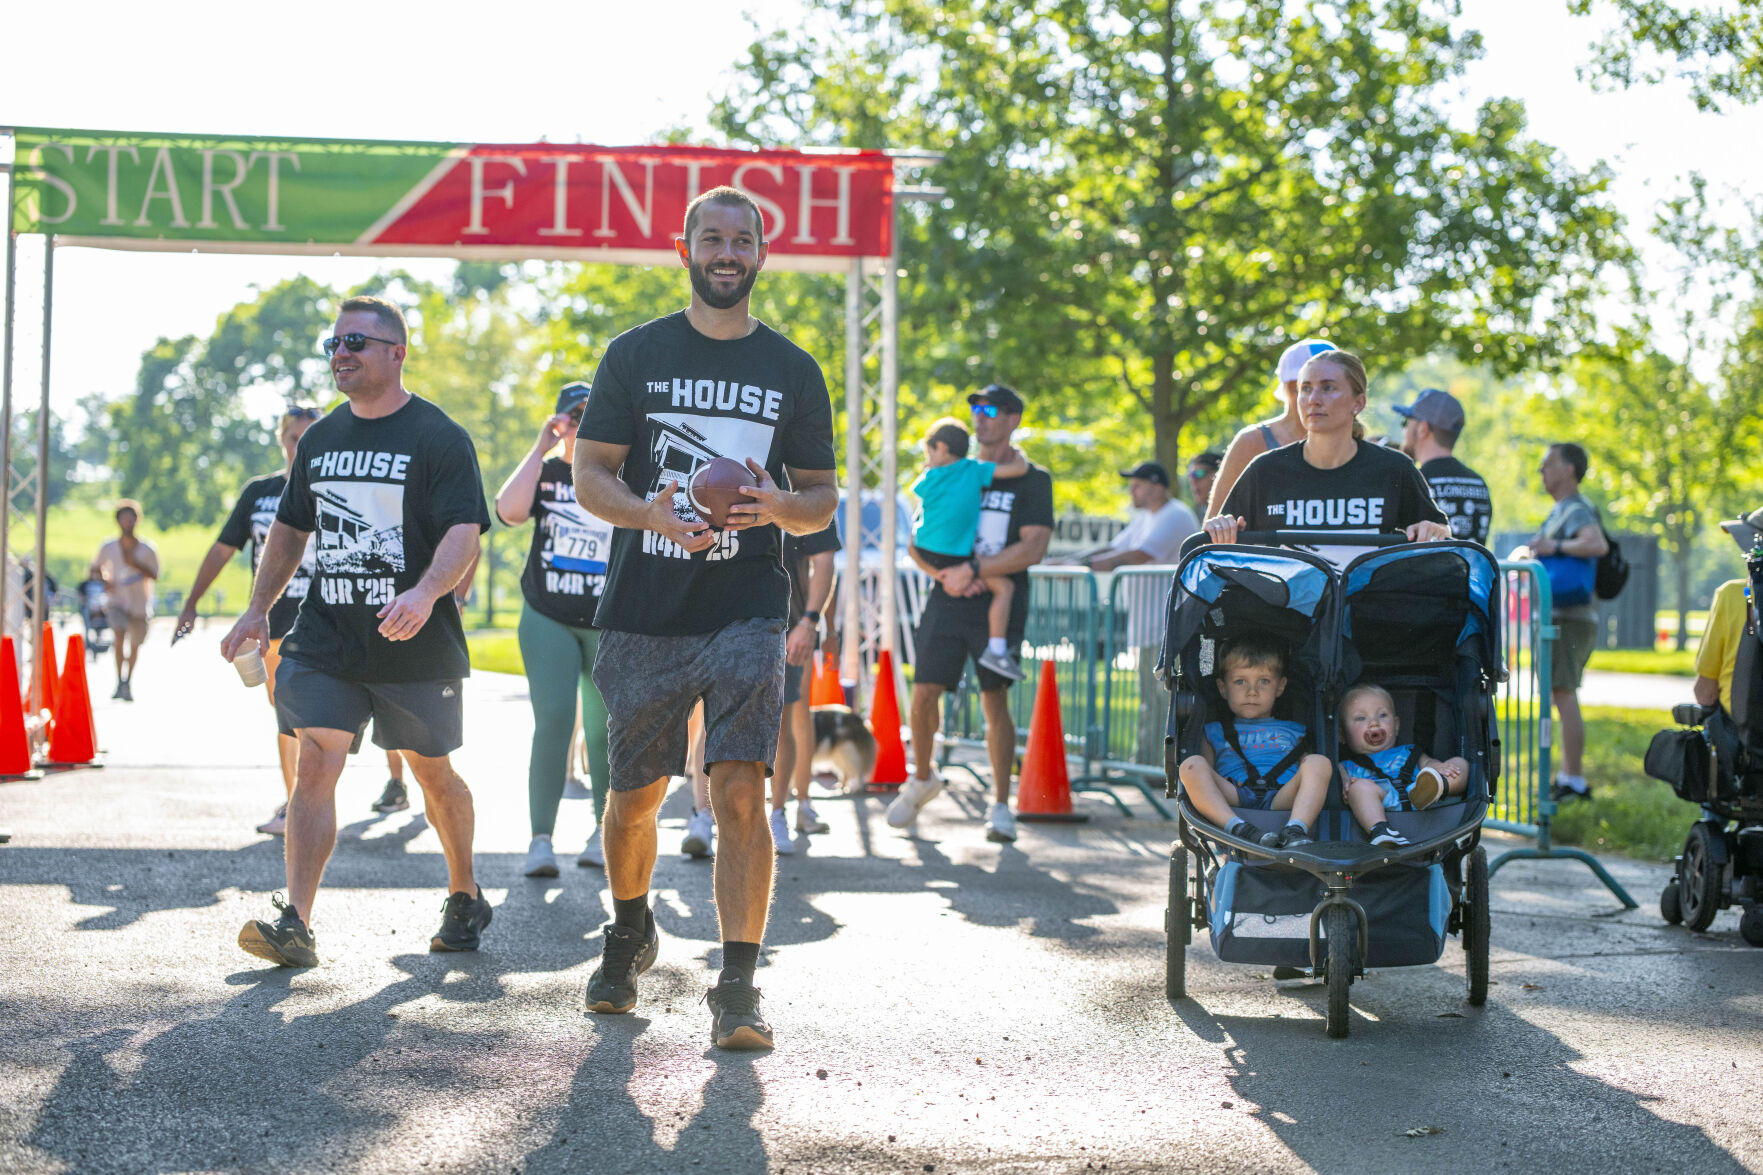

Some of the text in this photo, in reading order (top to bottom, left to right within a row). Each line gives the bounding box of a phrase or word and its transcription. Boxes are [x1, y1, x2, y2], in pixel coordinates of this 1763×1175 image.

[28, 142, 300, 232] START
[646, 377, 783, 421] THE HOUSE
[310, 450, 411, 480] THE HOUSE
[1267, 497, 1384, 526] THE HOUSE
[568, 536, 598, 558] 779
[545, 570, 606, 597] R4R '2
